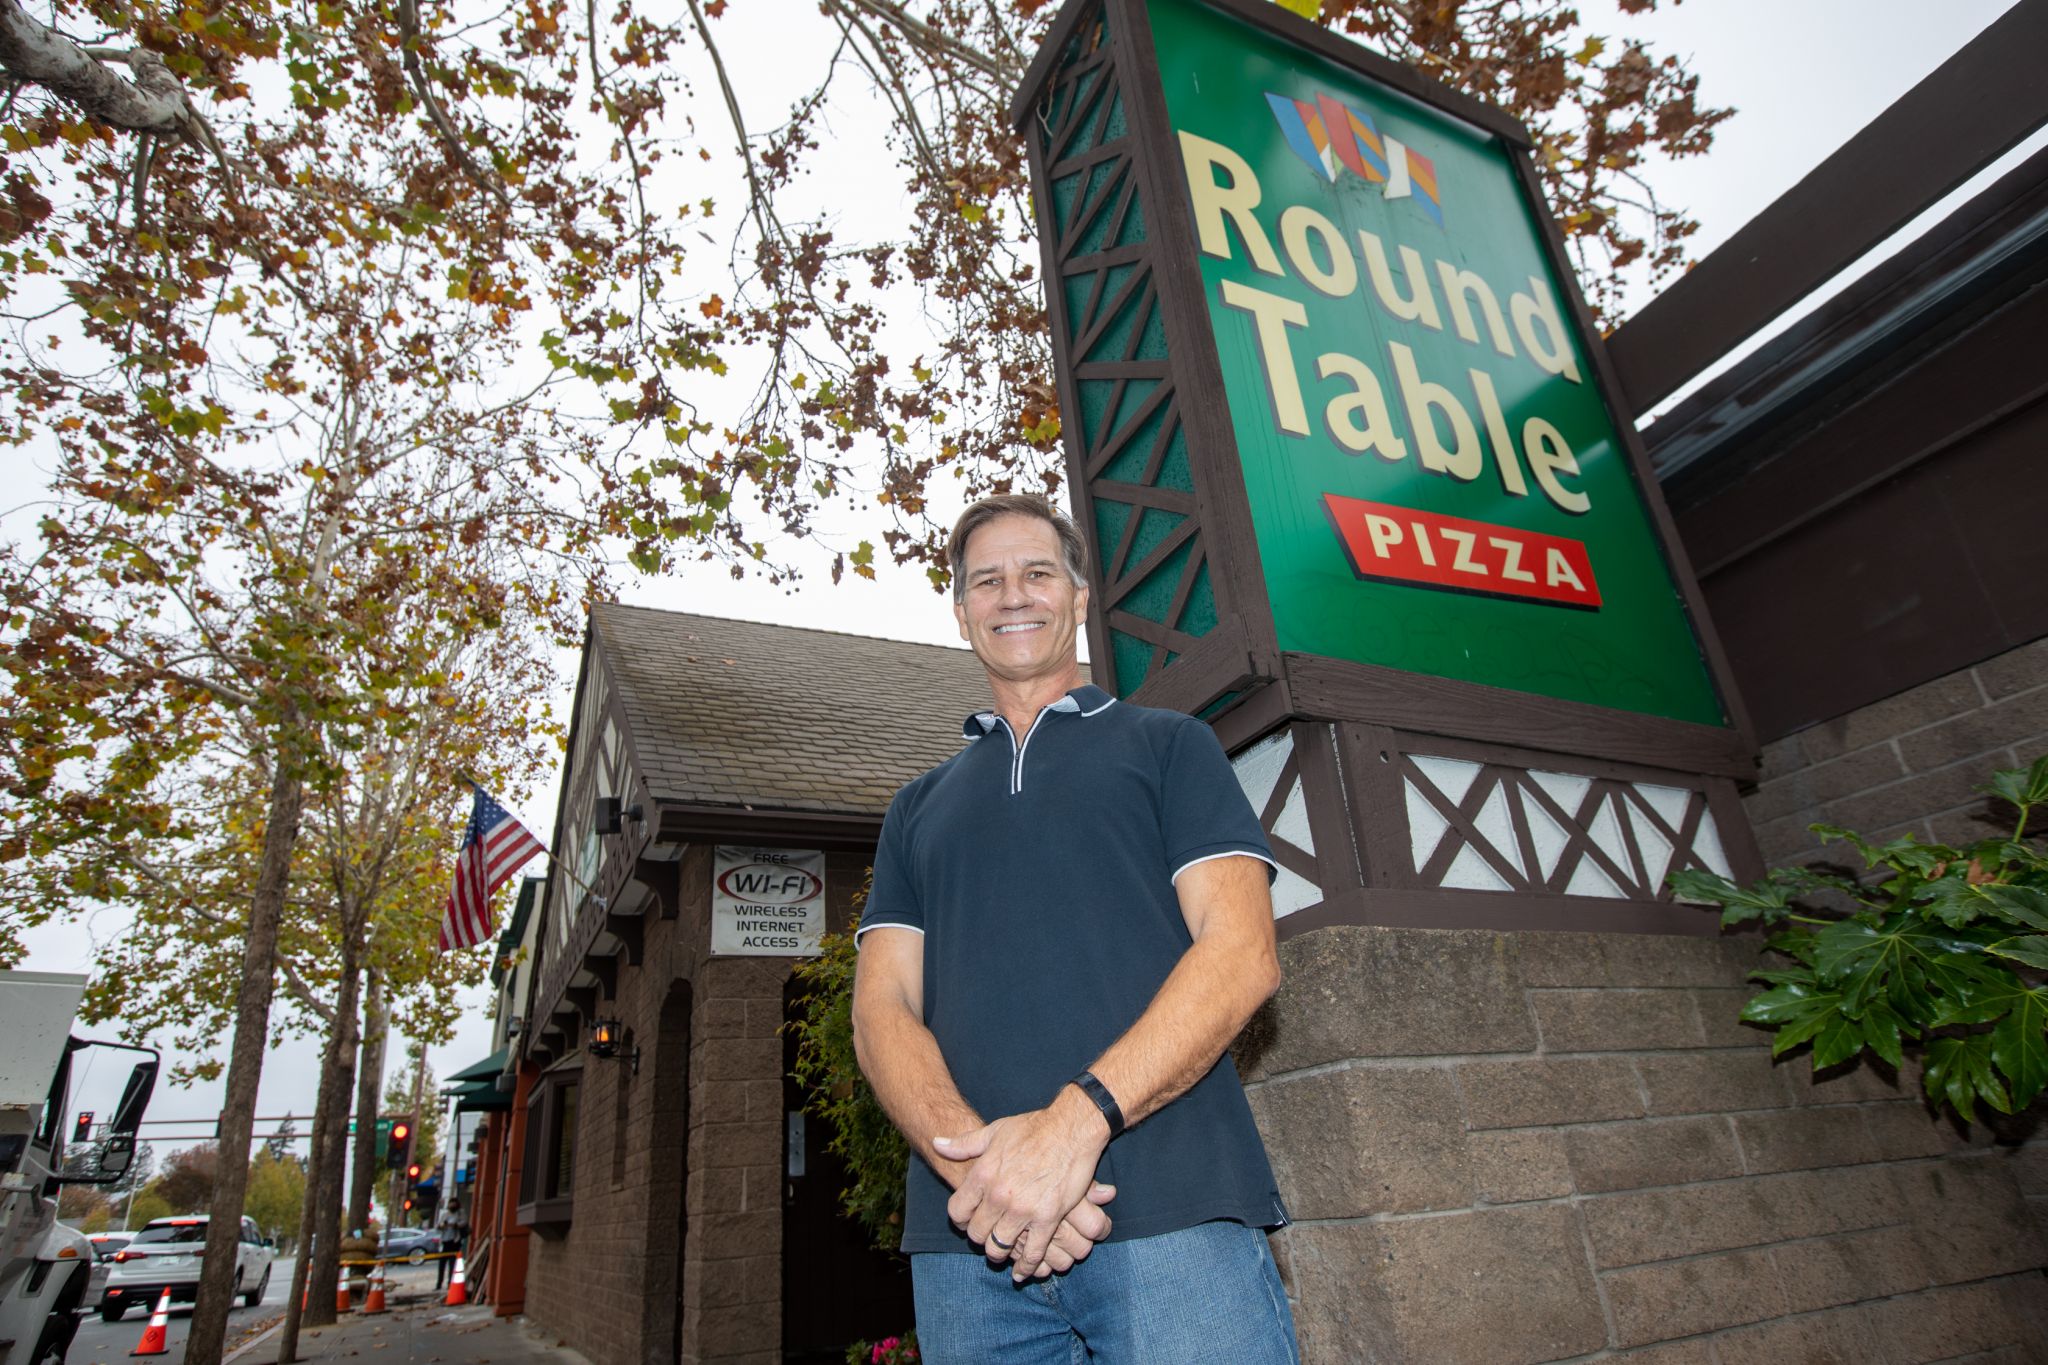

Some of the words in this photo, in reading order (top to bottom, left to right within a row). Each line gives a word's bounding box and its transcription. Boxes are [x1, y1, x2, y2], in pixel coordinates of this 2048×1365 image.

[1177, 130, 1582, 384] Round
[1221, 279, 1592, 513] Table
[1365, 513, 1586, 592] PIZZA
[753, 853, 789, 864] FREE
[735, 905, 807, 917] WIRELESS
[737, 921, 805, 932] INTERNET
[742, 937, 798, 947] ACCESS
